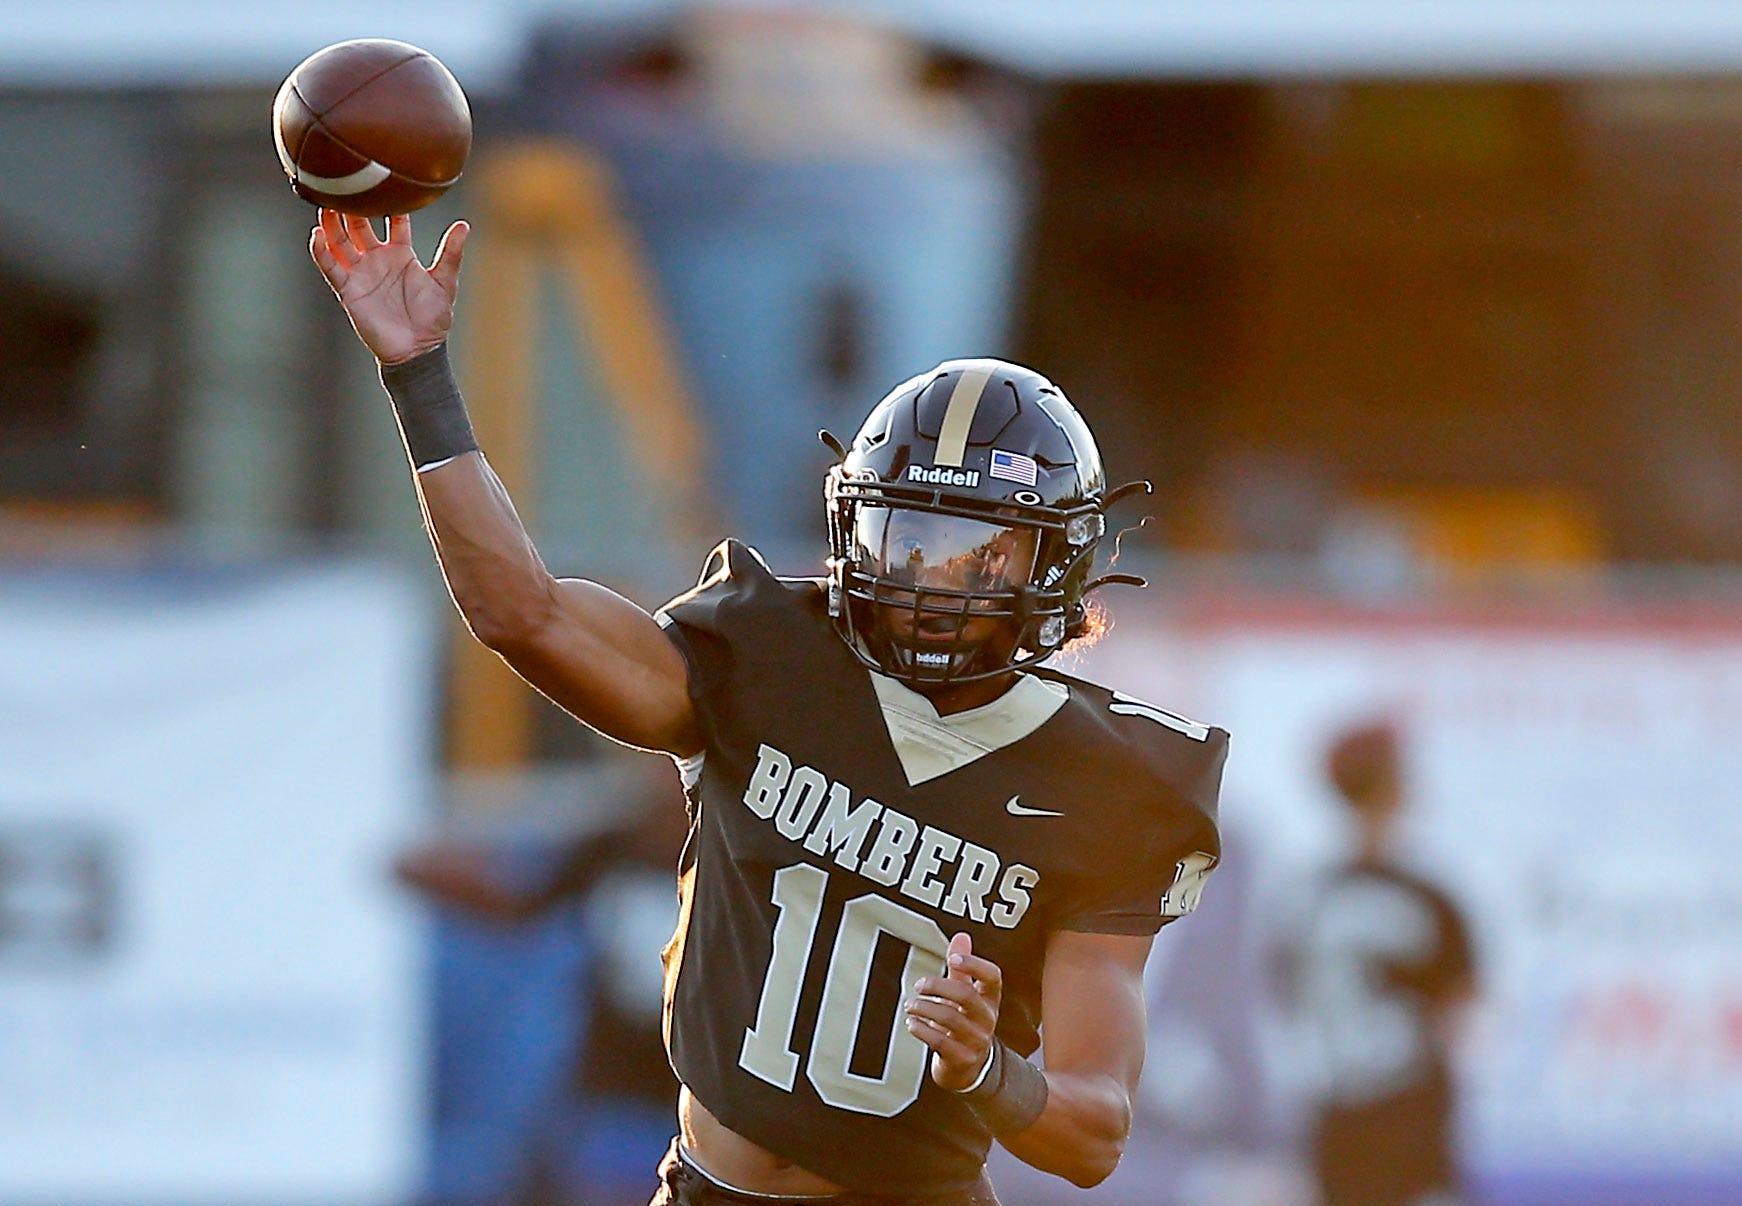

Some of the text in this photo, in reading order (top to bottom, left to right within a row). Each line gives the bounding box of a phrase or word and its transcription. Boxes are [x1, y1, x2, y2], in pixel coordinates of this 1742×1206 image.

[908, 465, 980, 487] Riddell
[743, 743, 1041, 929] BOMBERS
[738, 862, 949, 1118] 10
